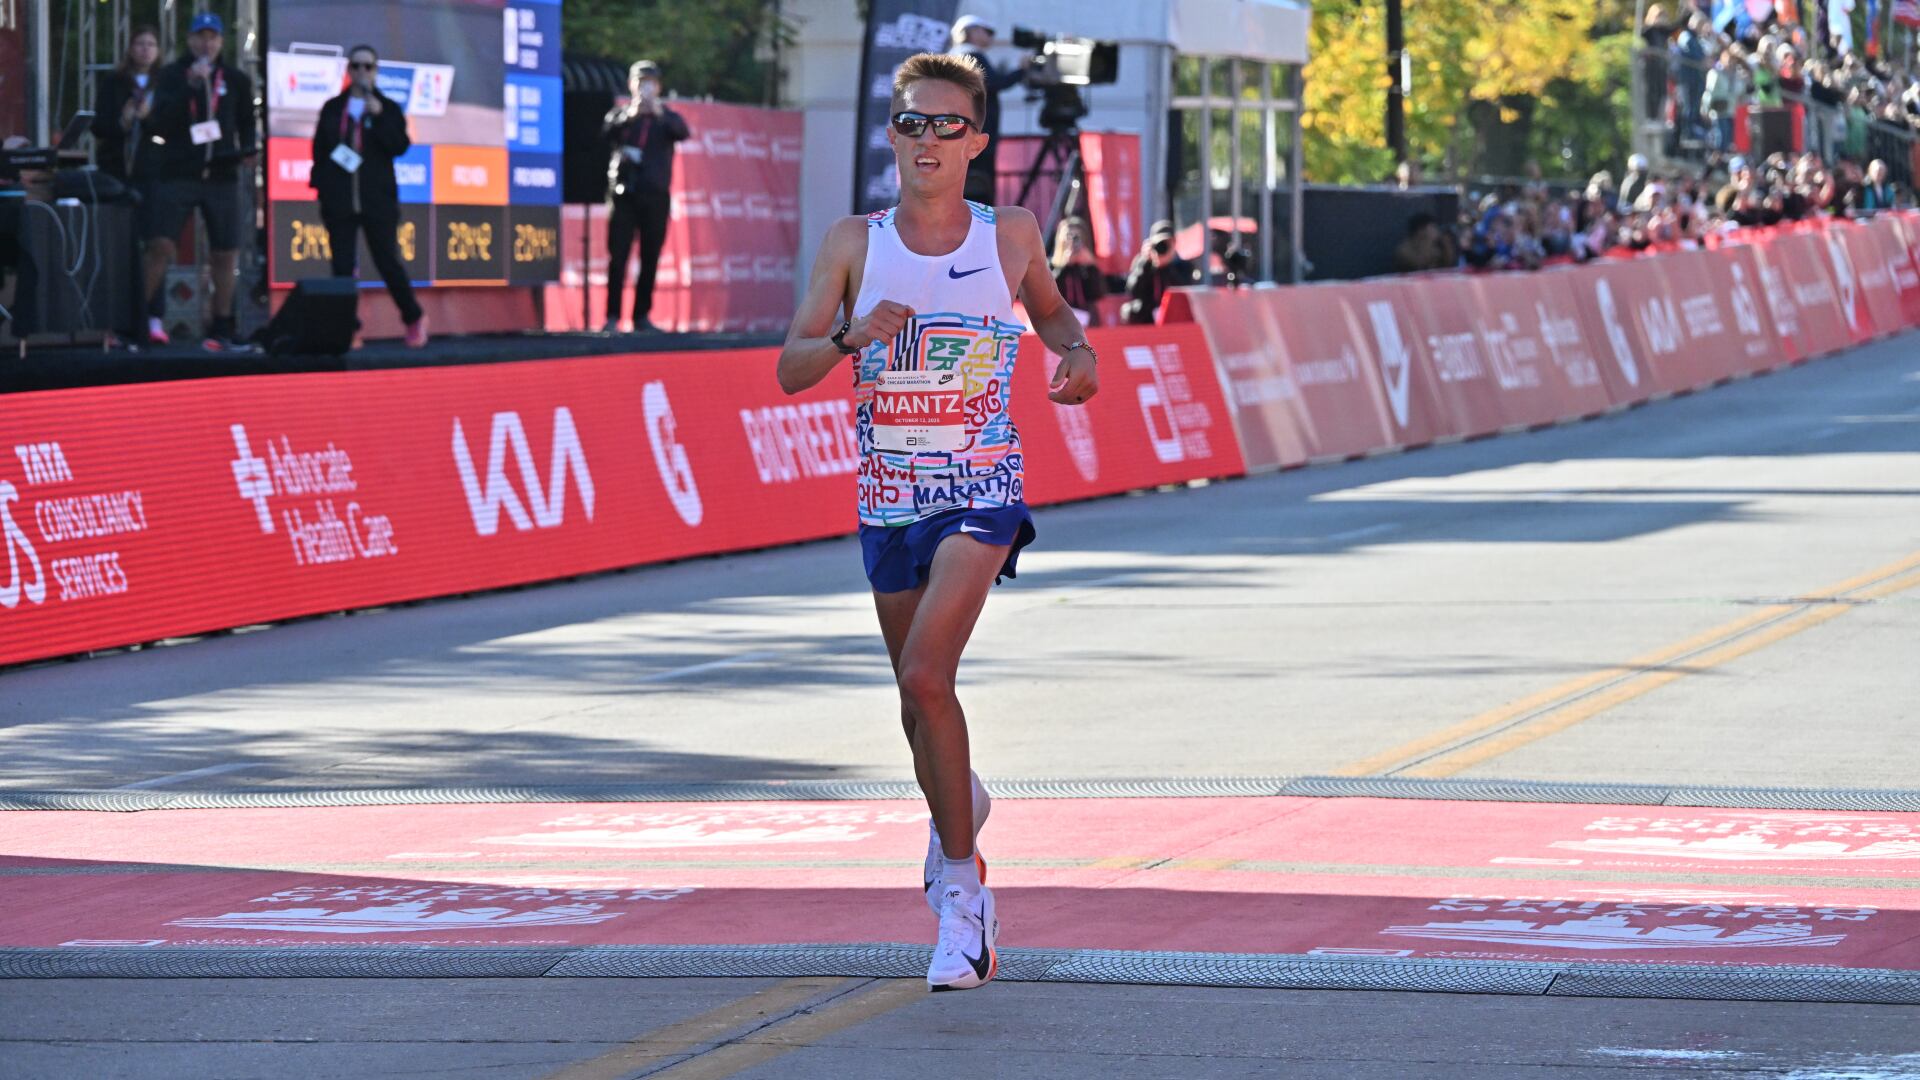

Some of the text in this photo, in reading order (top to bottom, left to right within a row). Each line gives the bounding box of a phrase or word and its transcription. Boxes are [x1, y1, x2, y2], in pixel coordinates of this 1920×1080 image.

[876, 394, 961, 414] MANTZ
[14, 441, 74, 485] TATA
[739, 399, 858, 483] BIOFREEZE
[267, 434, 358, 496] Advocate
[451, 407, 595, 536] KIA
[34, 489, 149, 543] CONSULTANCY
[282, 499, 399, 566] Health Care
[51, 551, 129, 602] SERVICES
[247, 894, 679, 902] MARATHON
[271, 887, 698, 897] CHICAGO
[1427, 904, 1870, 921] MARATHON
[1438, 898, 1879, 915] CHICAGO
